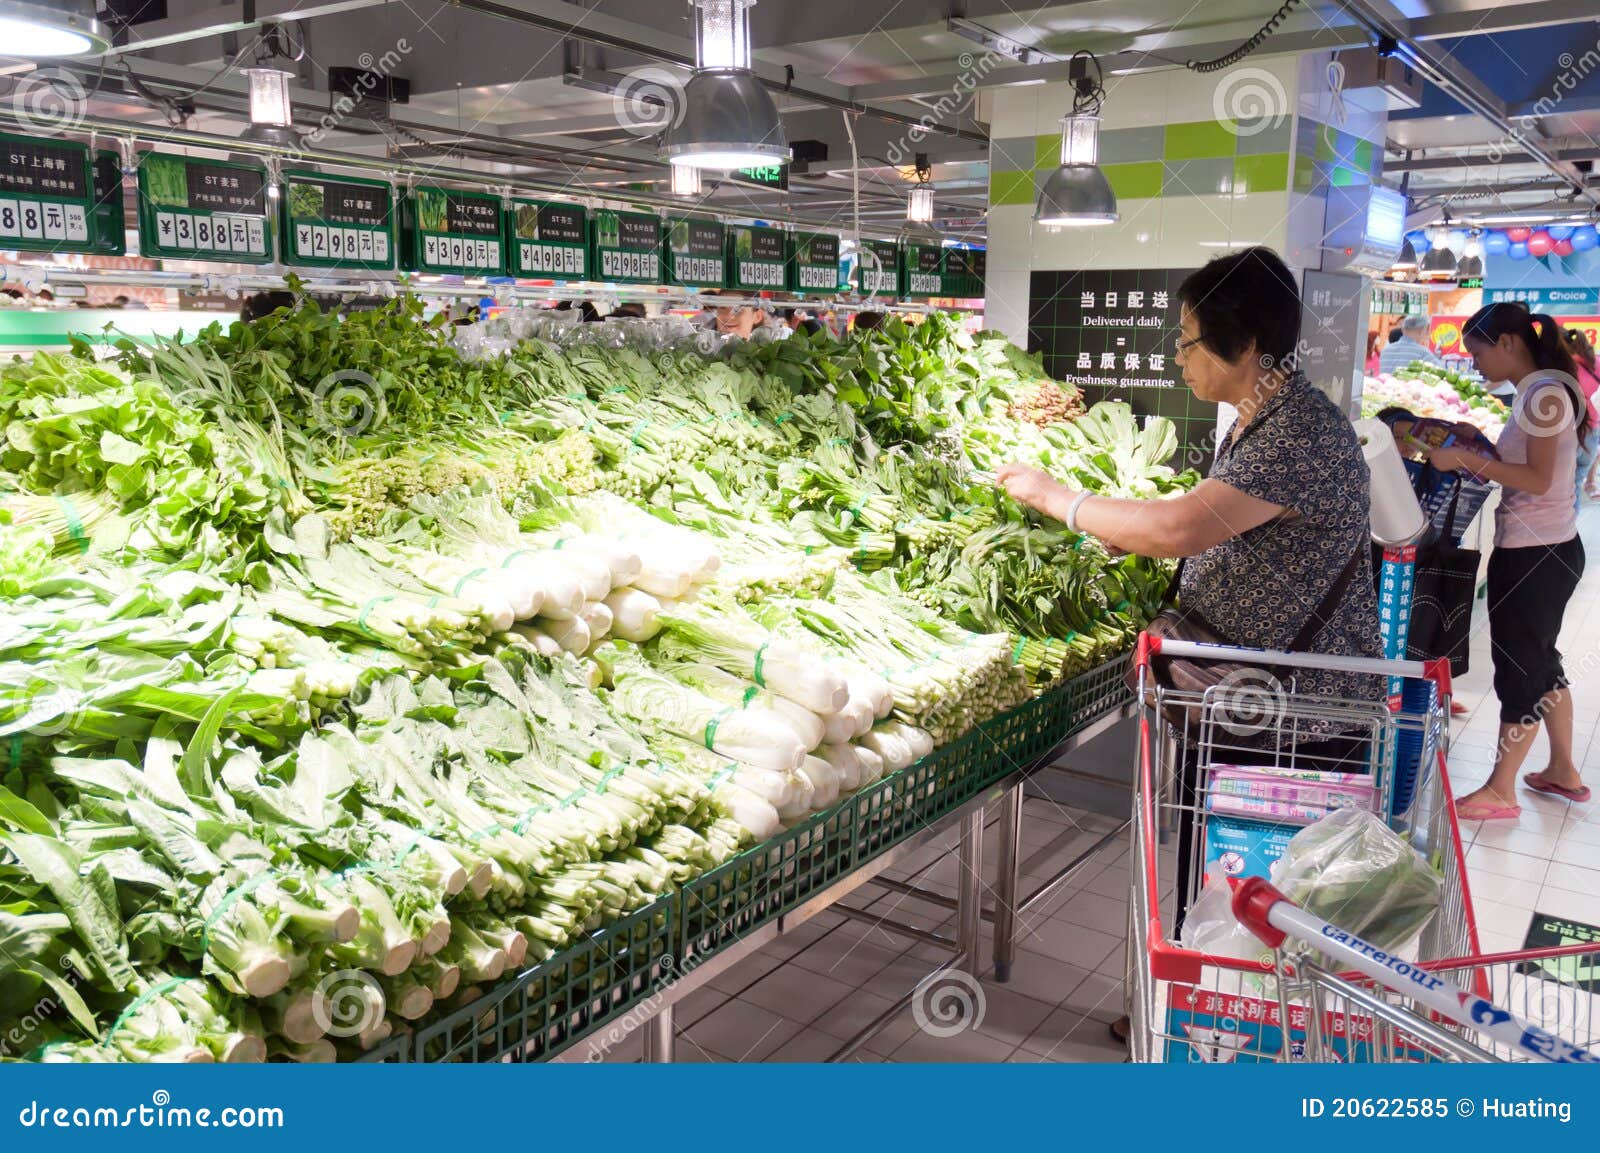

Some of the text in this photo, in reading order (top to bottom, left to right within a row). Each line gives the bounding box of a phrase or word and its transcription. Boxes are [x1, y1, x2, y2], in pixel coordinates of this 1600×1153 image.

[10, 154, 66, 171] ST 上海青
[204, 175, 218, 185] ST
[343, 199, 354, 208] ST
[1080, 291, 1169, 309] 当日配送
[1548, 290, 1588, 301] Choice
[1082, 314, 1164, 329] Delivered daily
[1076, 352, 1166, 372] 品质保证
[1065, 373, 1176, 389] Freshness guarantee
